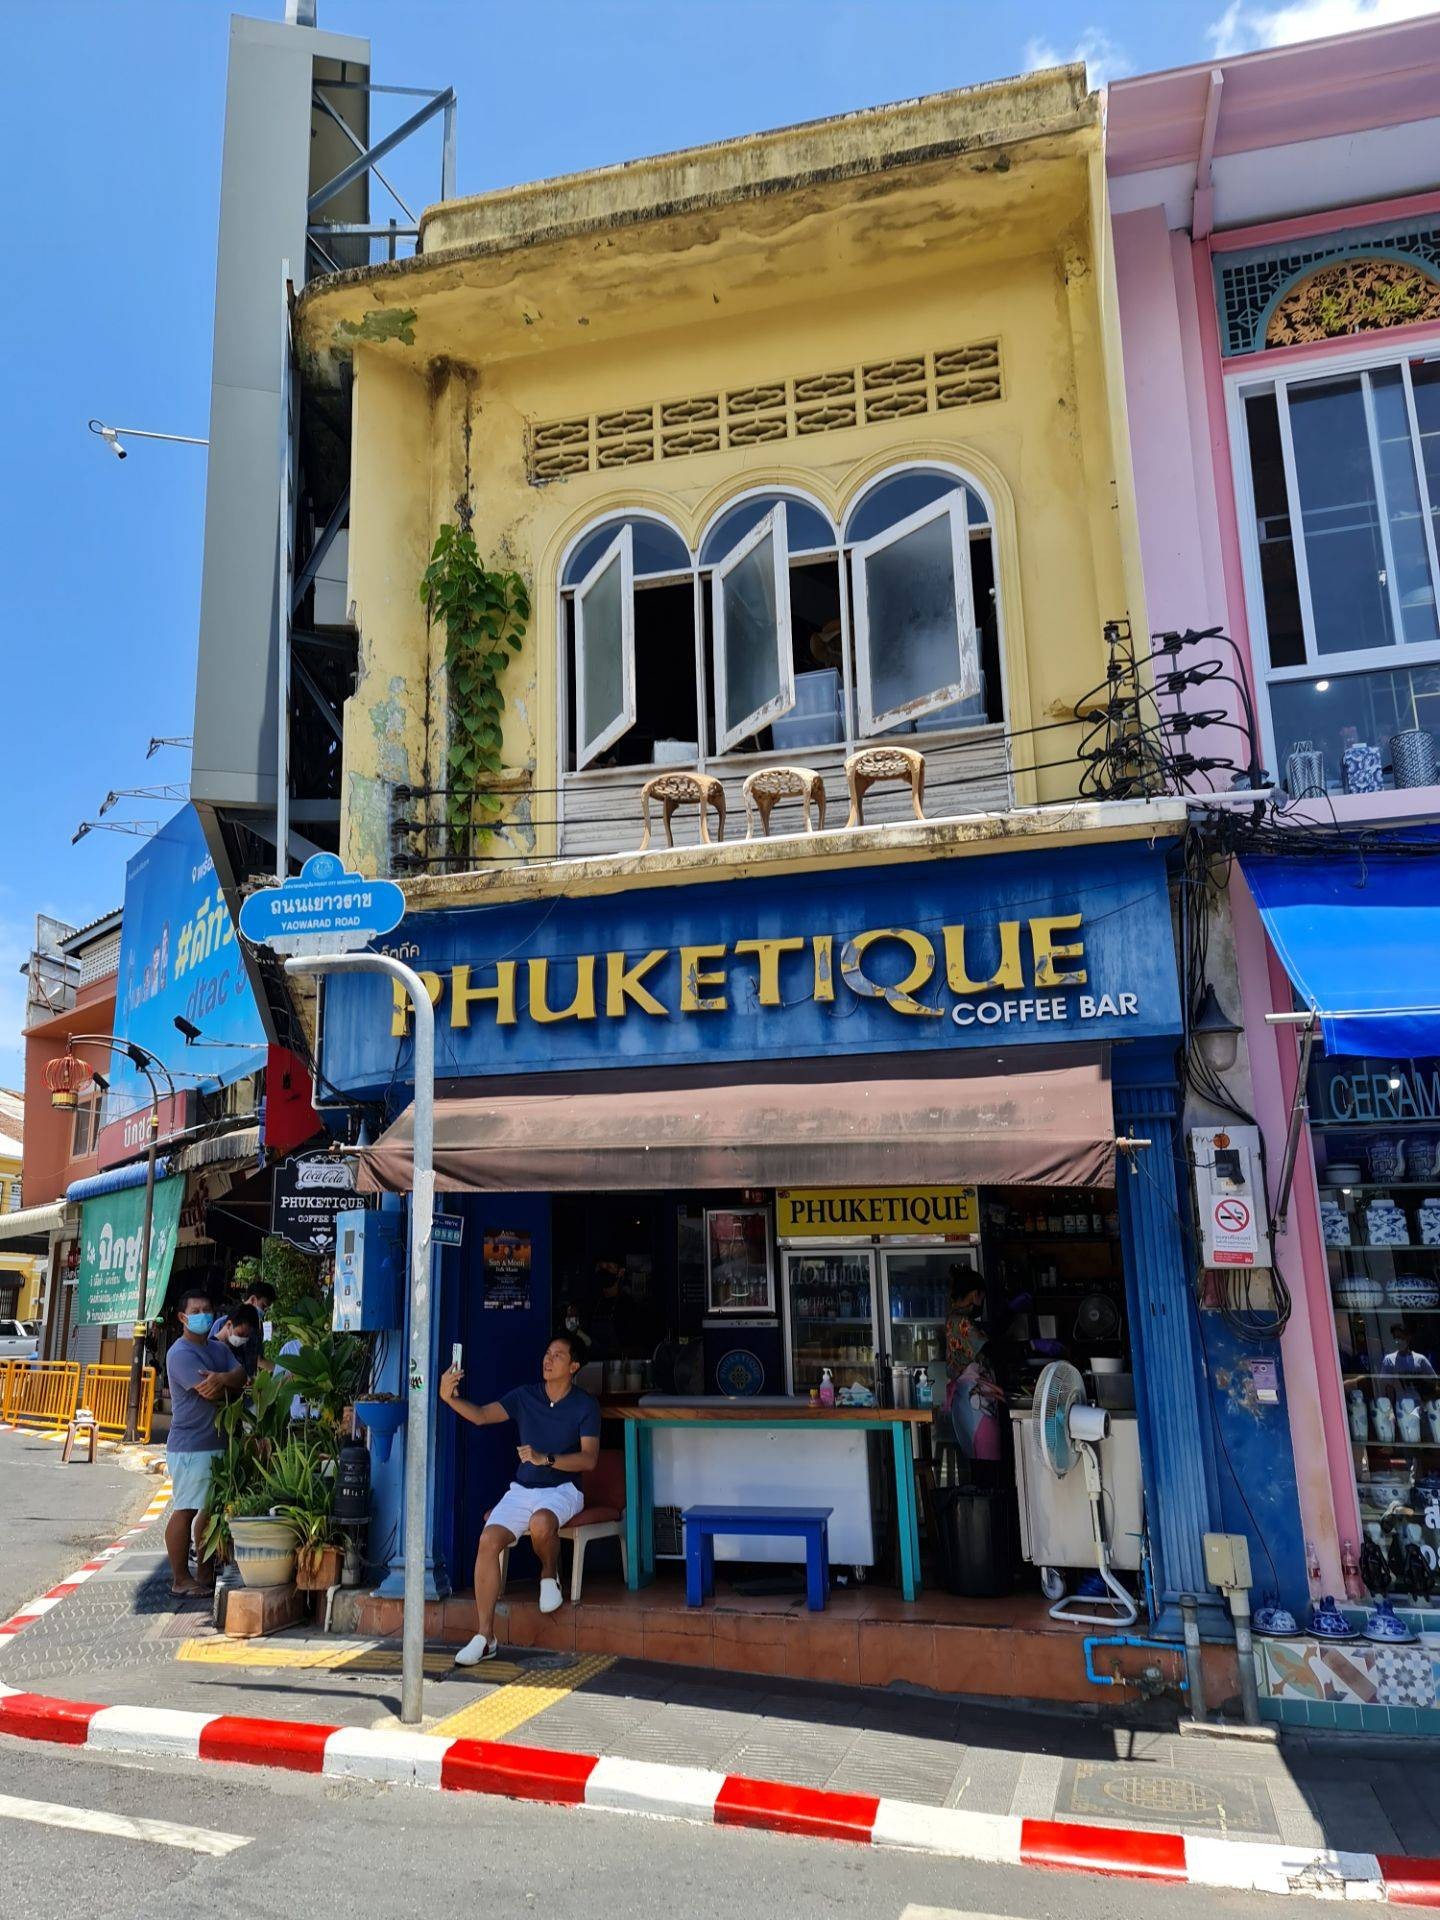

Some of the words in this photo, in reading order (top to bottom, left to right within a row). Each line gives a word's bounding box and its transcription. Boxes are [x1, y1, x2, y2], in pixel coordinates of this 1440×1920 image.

[271, 892, 372, 915] ถนนเยาวราช
[281, 918, 331, 931] YAOWARAD
[335, 916, 360, 926] ROAD
[391, 913, 1088, 1037] PHUKETIQUE
[185, 968, 230, 1023] dtac
[952, 997, 1067, 1026] COFFEE
[1080, 993, 1139, 1018] BAR
[280, 1196, 365, 1209] PHUKETIQUE
[790, 1196, 970, 1226] PHUKETIQUE
[297, 1214, 329, 1223] COFFEE
